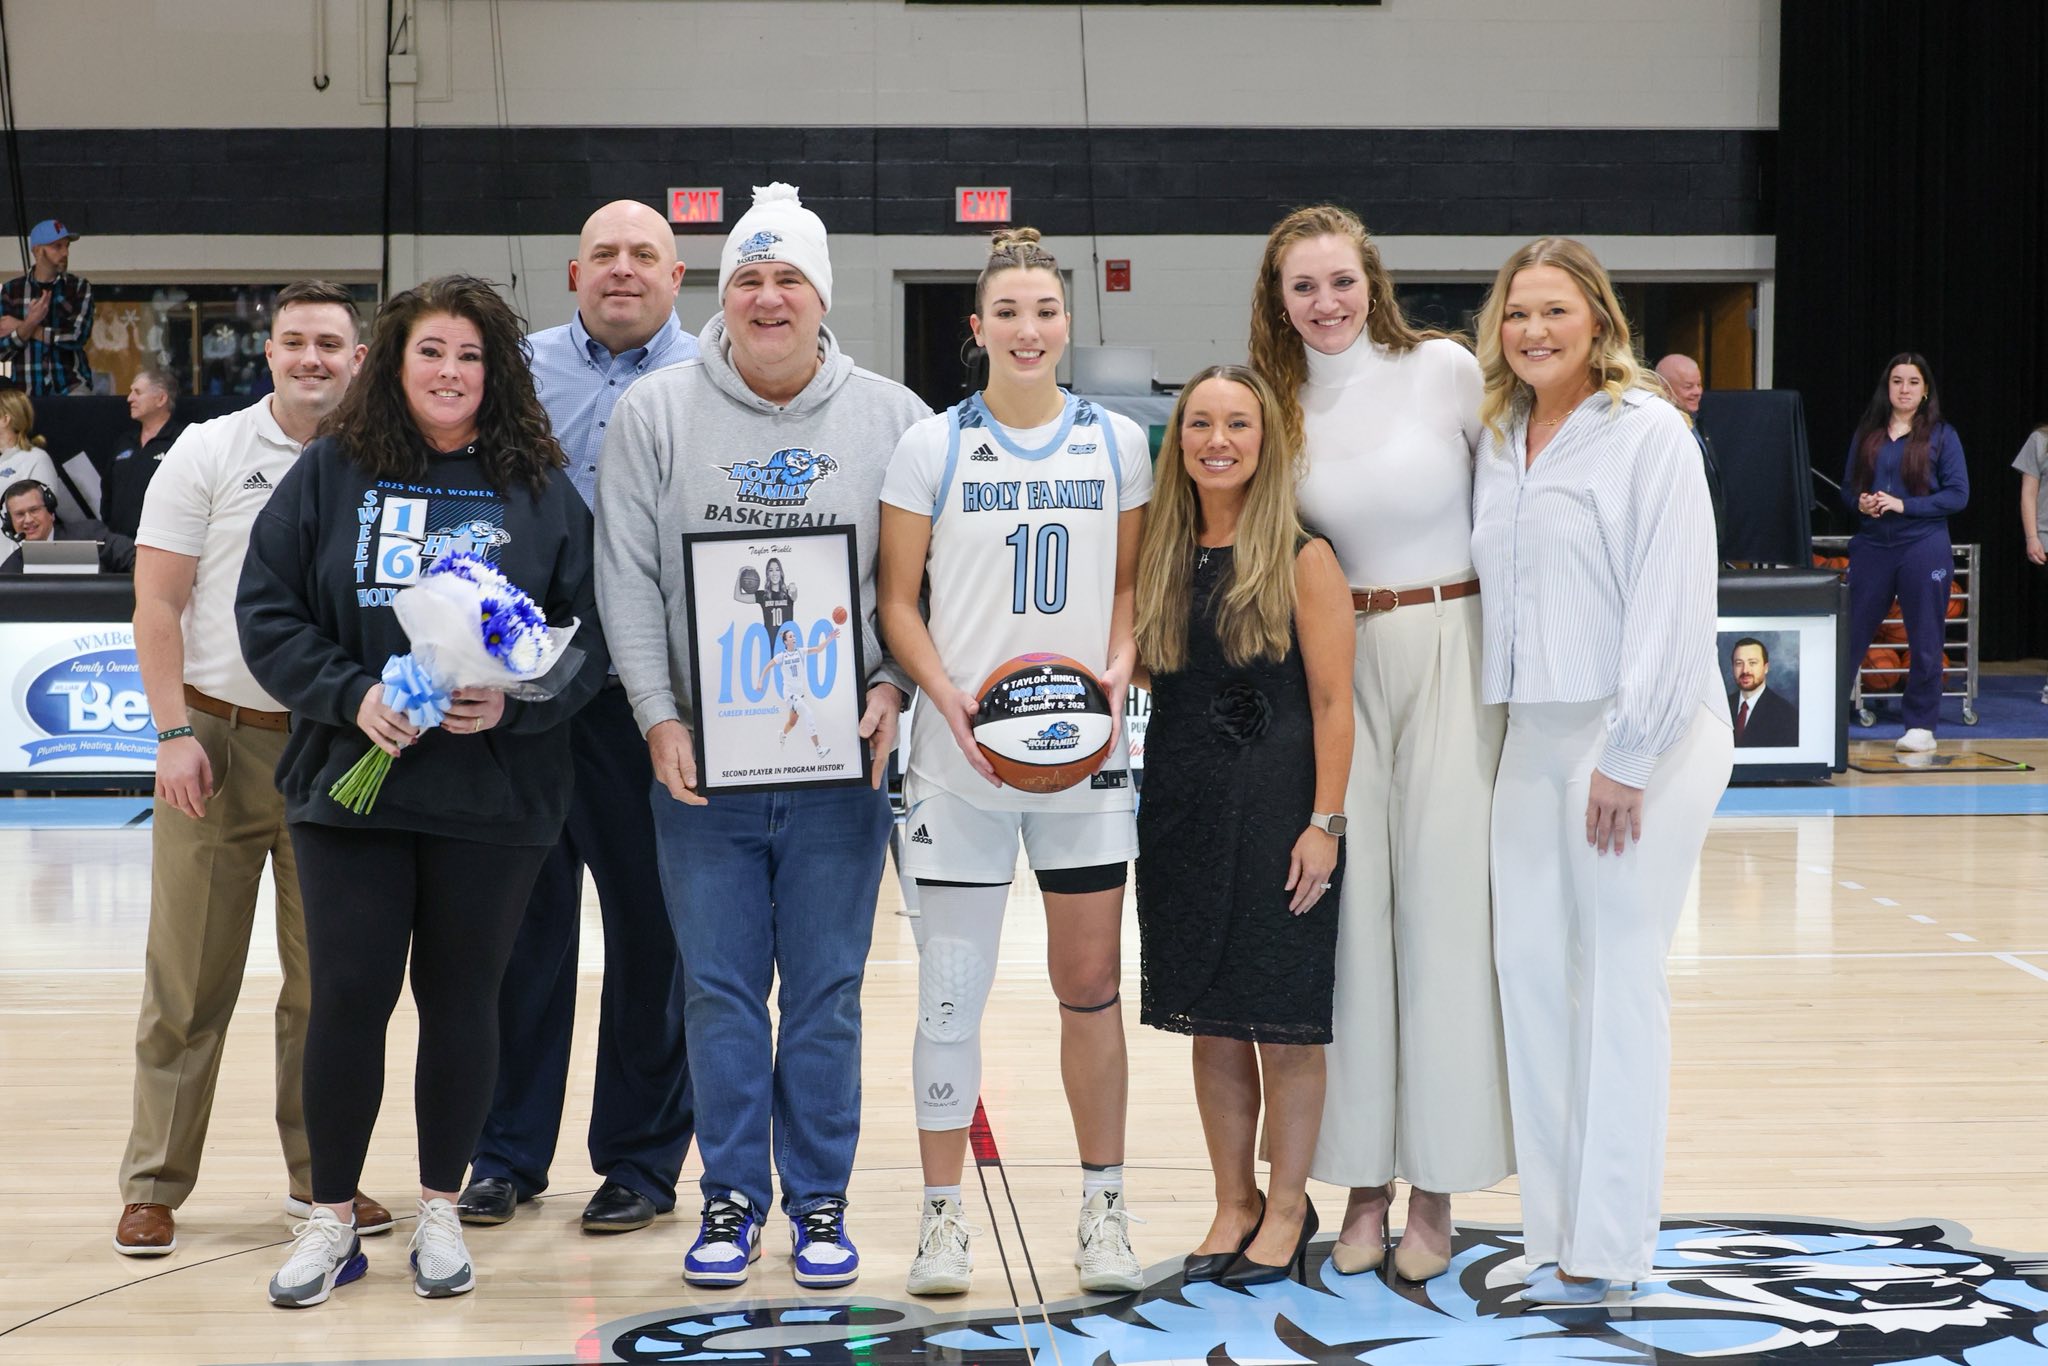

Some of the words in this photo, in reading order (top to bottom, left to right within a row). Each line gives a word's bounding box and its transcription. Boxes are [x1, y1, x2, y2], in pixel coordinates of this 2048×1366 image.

[673, 191, 720, 220] EXIT
[961, 191, 1008, 220] EXIT
[737, 253, 776, 265] BASKETBALL
[970, 453, 998, 462] adidas
[731, 464, 782, 484] HOLY
[243, 482, 273, 490] adidas
[377, 480, 404, 490] 2025
[408, 485, 443, 495] NCAA
[739, 480, 811, 500] FAMILY
[741, 496, 802, 506] UNIVERSITY
[962, 481, 1022, 512] HOLY
[1026, 480, 1106, 510] FAMILY
[704, 504, 837, 529] BASKETBALL
[353, 489, 381, 584] SWEET
[748, 545, 769, 556] Taylor
[770, 544, 792, 553] Hinkle
[1006, 523, 1070, 615] 10
[356, 587, 399, 608] HOLY
[70, 660, 104, 678] Family
[1010, 675, 1048, 689] TAYLOR
[1050, 674, 1081, 683] HINKLE
[47, 681, 157, 732] Be
[719, 709, 743, 718] CAREER
[745, 705, 780, 716] REBOUNDS
[1013, 702, 1056, 714] FEBRUARY
[36, 743, 78, 757] Plumbing,
[80, 740, 113, 752] Heating,
[1028, 738, 1050, 748] HOLY
[1049, 736, 1080, 747] FAMILY
[722, 769, 748, 778] SECOND
[749, 768, 773, 776] PLAYER
[774, 767, 782, 775] IN
[783, 764, 816, 774] PROGRAM
[817, 763, 845, 772] HISTORY
[911, 835, 933, 845] adidas
